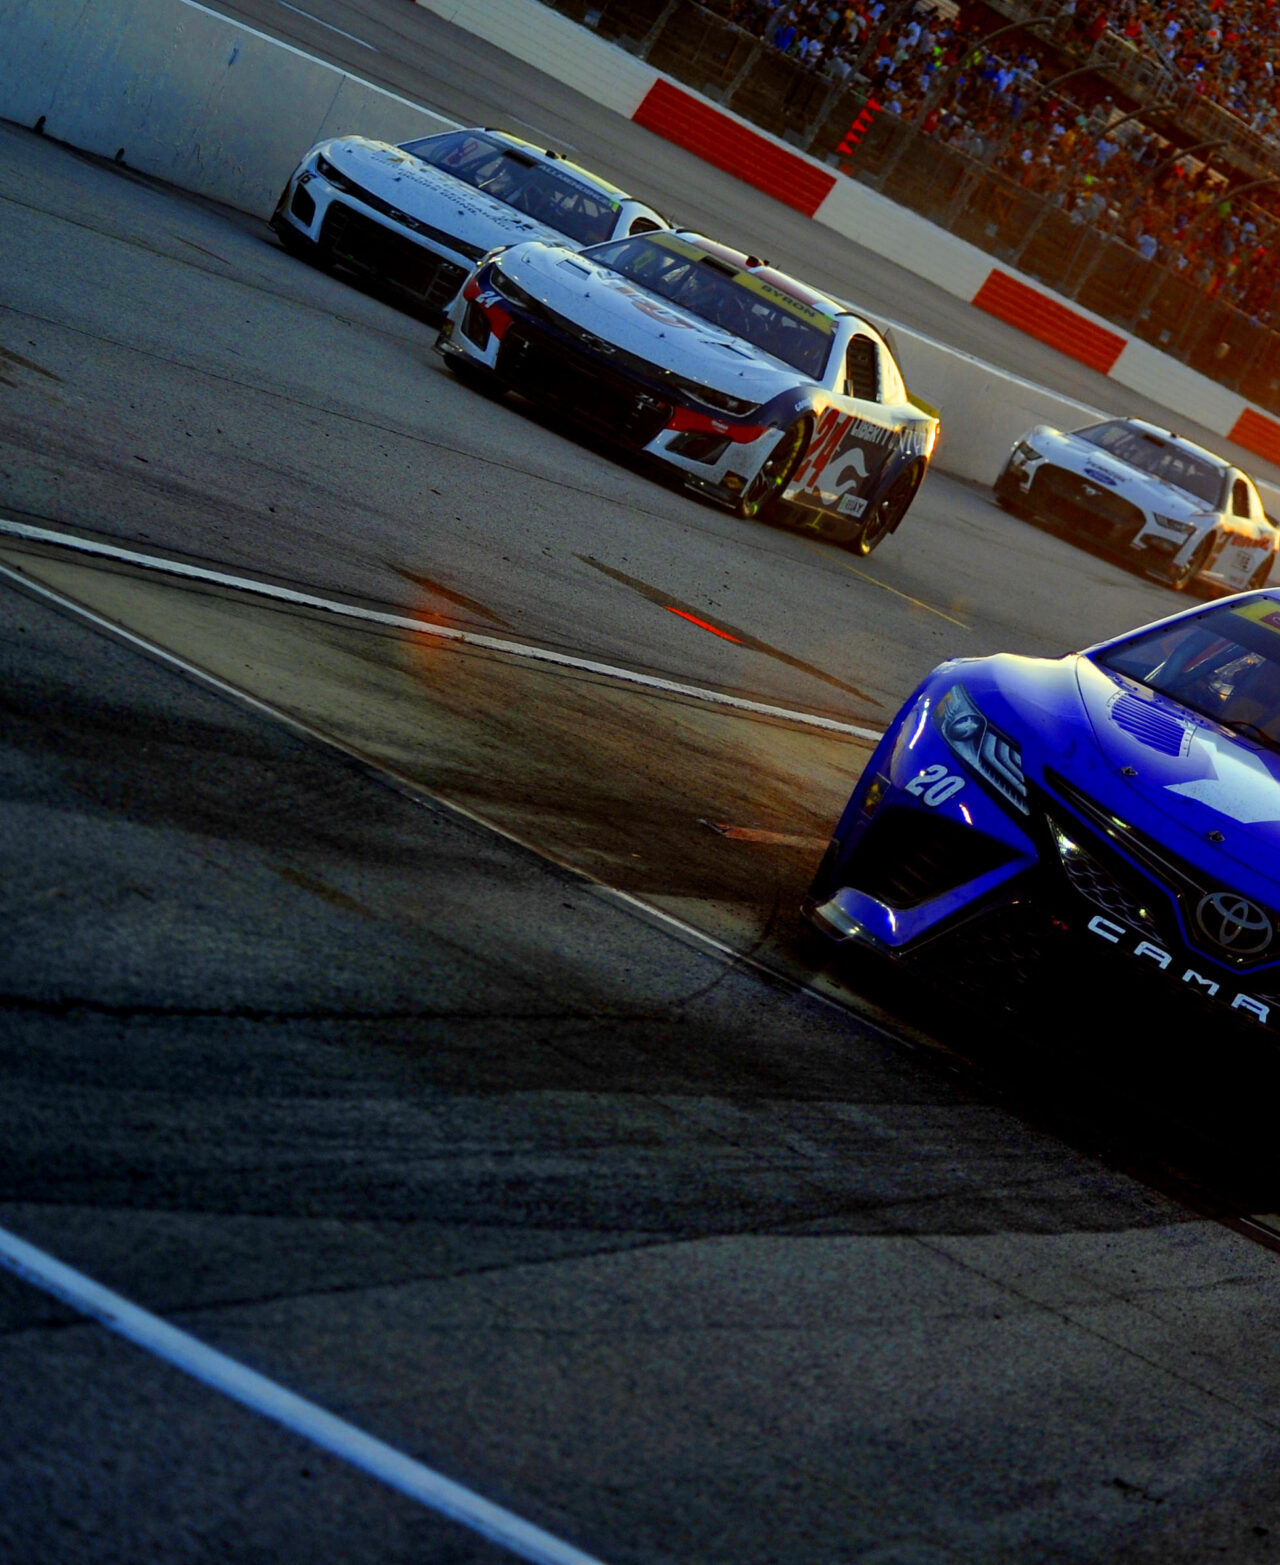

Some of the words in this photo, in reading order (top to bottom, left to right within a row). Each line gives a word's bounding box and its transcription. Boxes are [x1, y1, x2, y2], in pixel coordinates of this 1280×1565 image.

[761, 284, 816, 318] BYRON
[793, 406, 854, 494] 24
[904, 764, 965, 807] 20
